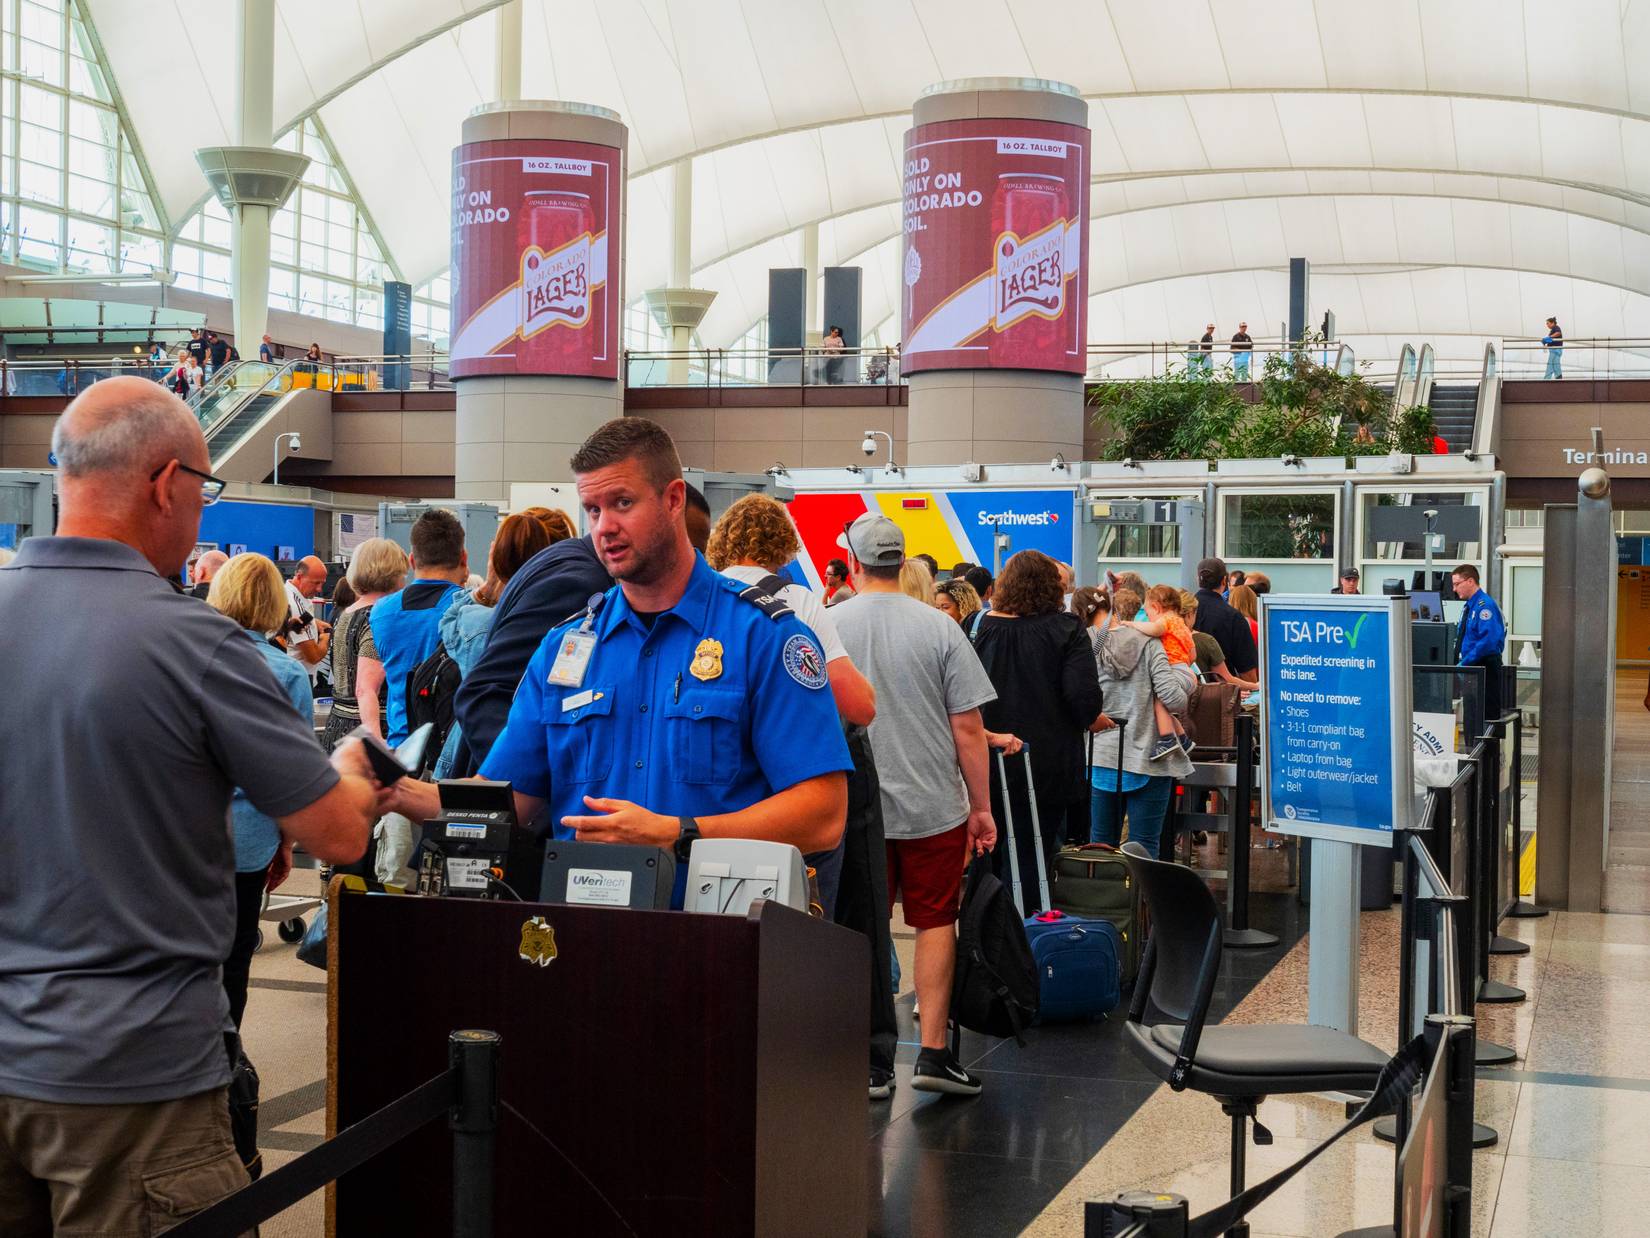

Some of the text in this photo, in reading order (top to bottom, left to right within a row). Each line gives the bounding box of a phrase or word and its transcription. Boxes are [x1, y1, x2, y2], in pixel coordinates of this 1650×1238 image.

[1002, 142, 1062, 153] 16 OZ. TALLBOY
[555, 162, 587, 171] TALLBOY
[904, 172, 962, 196] ONLY ON
[469, 190, 492, 207] ON
[904, 190, 983, 216] COLORADO
[1000, 249, 1061, 313] LAGER
[526, 262, 587, 323] LAGER
[1160, 502, 1171, 522] 1
[1280, 621, 1344, 644] TSA Pre
[1281, 654, 1376, 670] Expedited screening in
[1280, 669, 1317, 681] this lane.
[1280, 690, 1361, 705] No need to remove:
[1286, 706, 1310, 717] Shoes
[1287, 721, 1365, 739] 3-1-1 compliant bag
[1287, 736, 1340, 751] from carry-on
[1287, 752, 1352, 768] Laptop from bag
[1287, 766, 1378, 784] Light outerwear/jacket
[1286, 781, 1302, 793] Belt
